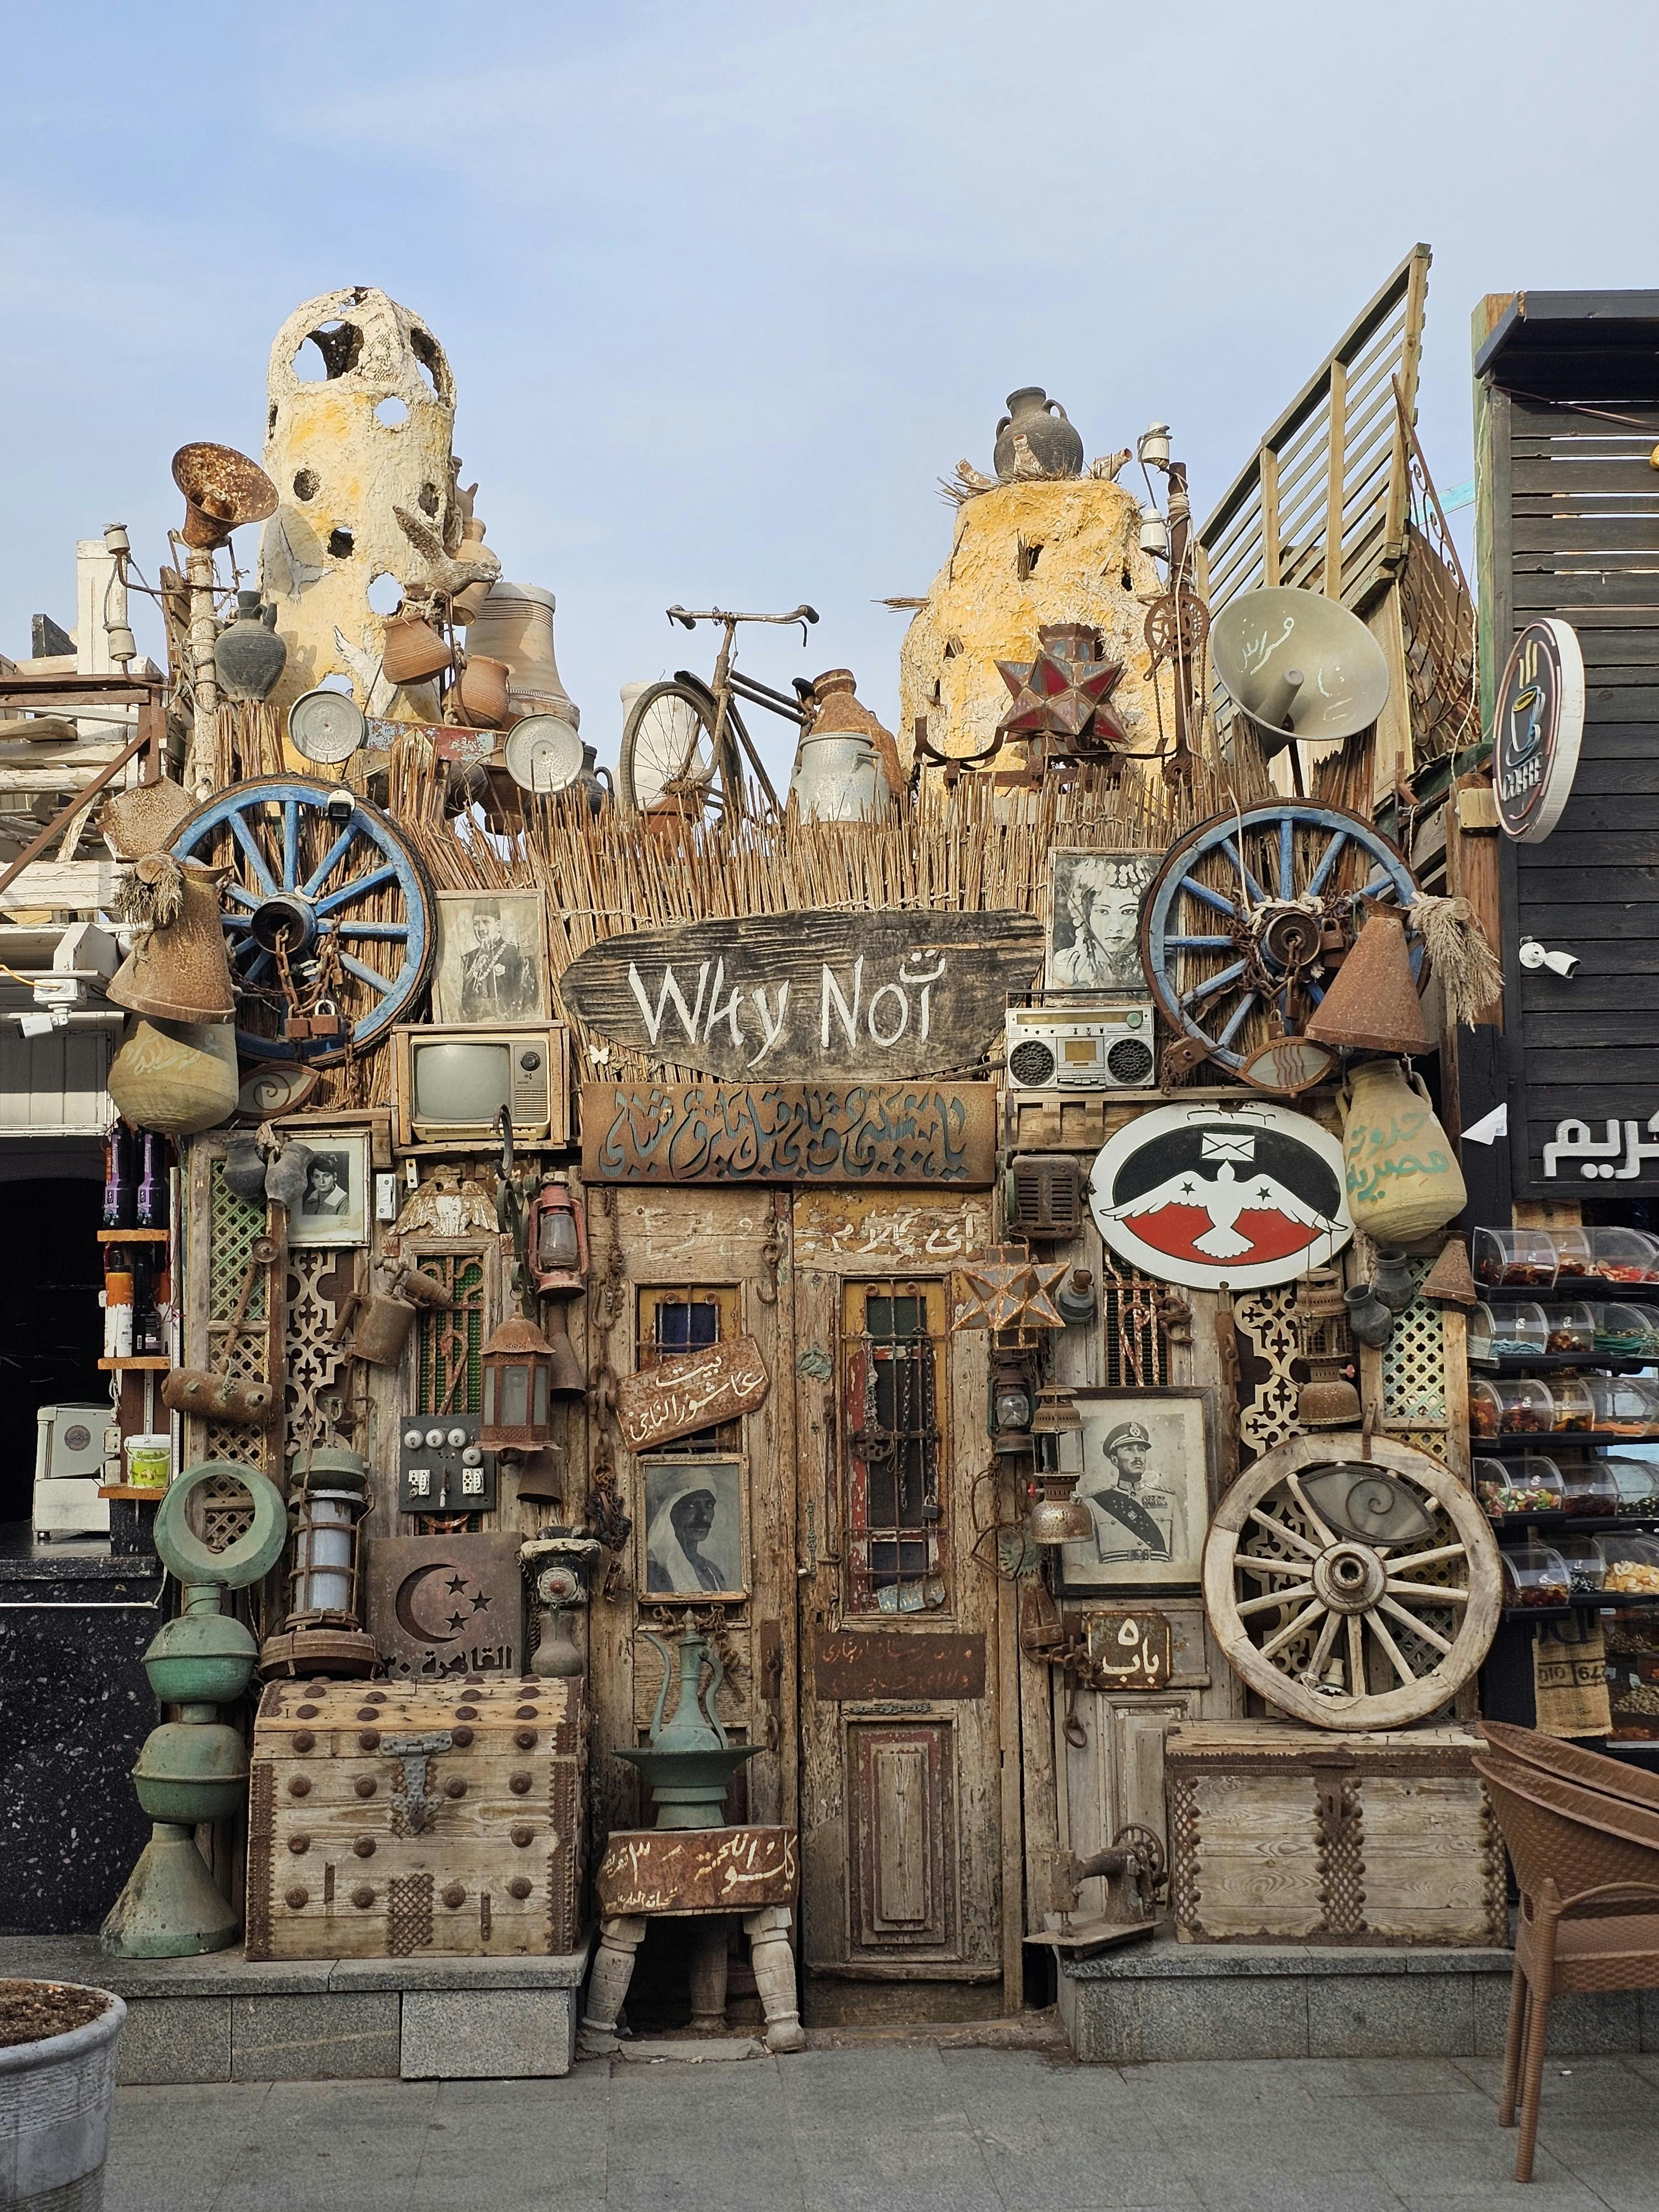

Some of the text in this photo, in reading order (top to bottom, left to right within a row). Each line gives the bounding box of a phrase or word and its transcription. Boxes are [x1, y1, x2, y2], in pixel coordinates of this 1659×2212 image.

[628, 955, 791, 1068] Why
[656, 1355, 722, 1387] بيت
[422, 1645, 513, 1679] القاهرة
[1102, 1636, 1159, 1684] باب
